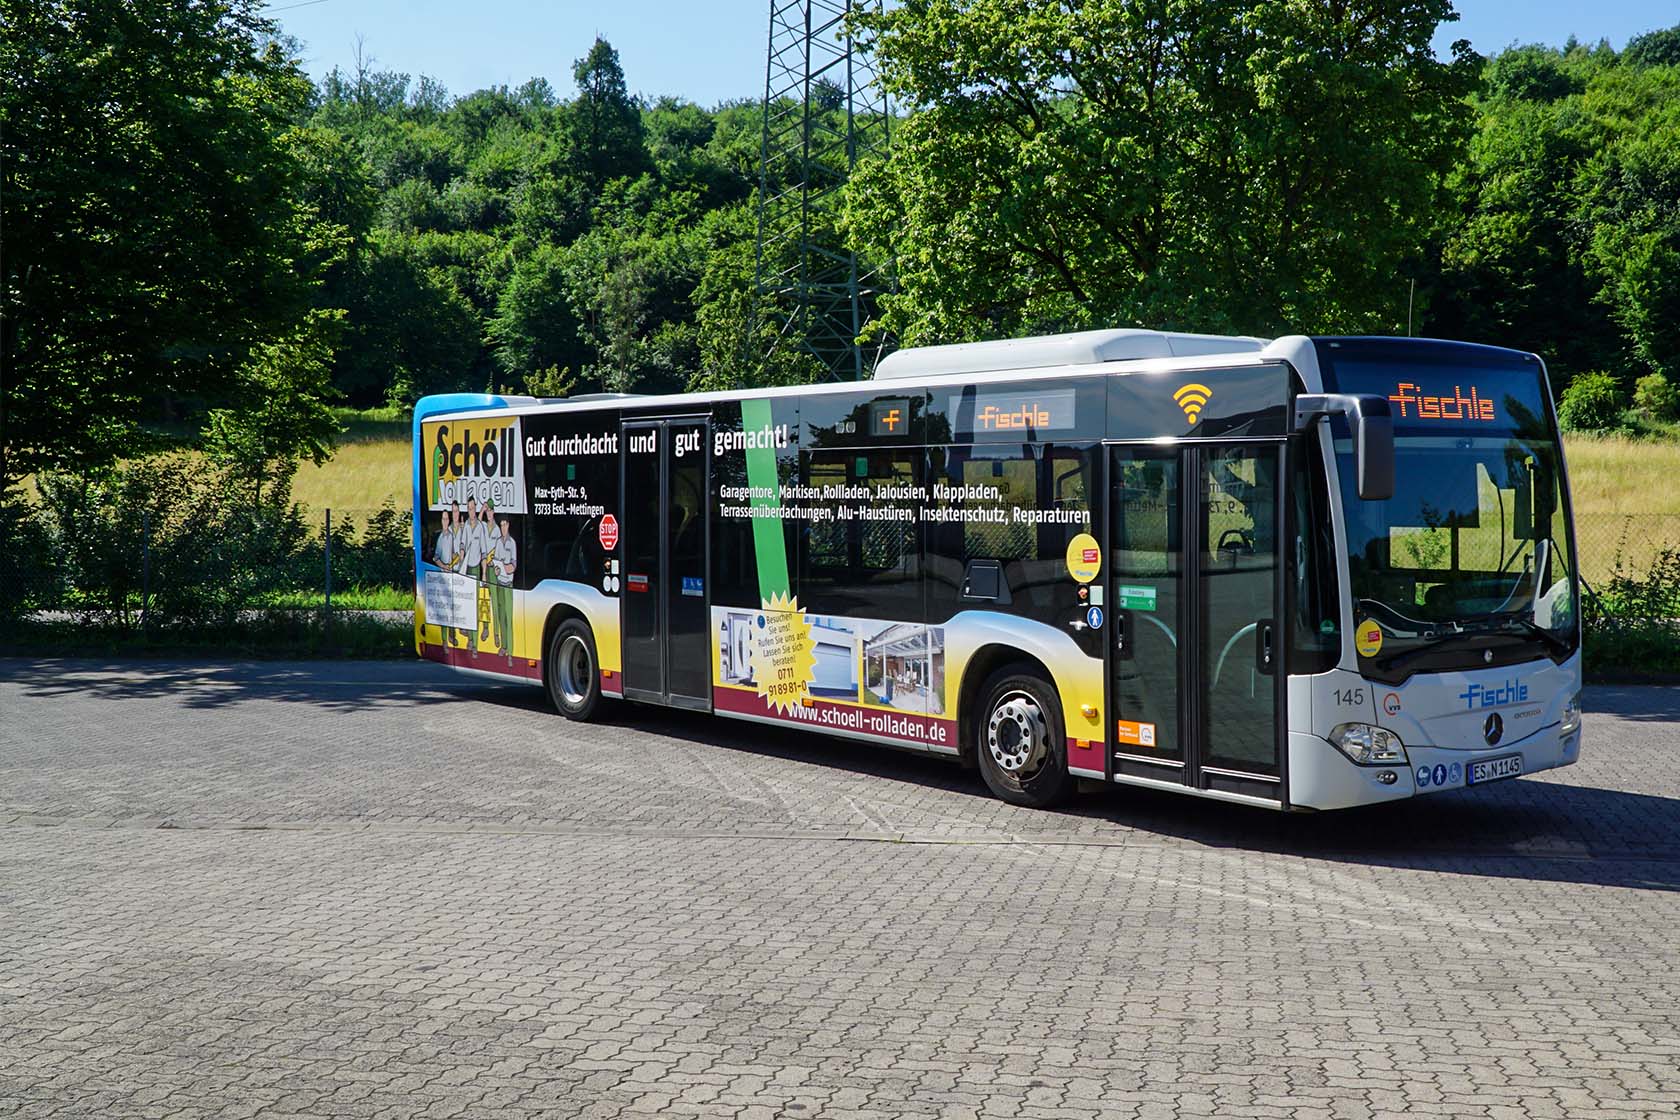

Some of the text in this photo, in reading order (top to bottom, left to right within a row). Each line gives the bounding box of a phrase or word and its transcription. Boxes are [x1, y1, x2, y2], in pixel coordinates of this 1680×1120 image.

[526, 424, 788, 458] Gut durchdacht und gut gemacht!
[437, 425, 515, 478] Schöll
[534, 486, 588, 501] Max-Eyth-Str. 9,
[720, 484, 776, 501] Garagentore,
[876, 483, 930, 502] Jalousien,
[933, 483, 1003, 502] Klappladen,
[534, 503, 605, 518] 73733 Essl.-Mettingen
[719, 503, 1091, 526] Terrassenüberdachungen, Alu-Haustüren, Insektenschutz, Reparaturen
[600, 523, 616, 534] STOP
[766, 613, 793, 625] Besuchen
[768, 625, 777, 635] Sie
[775, 636, 784, 645] Sie
[785, 634, 796, 642] uns
[796, 631, 806, 641] an!
[782, 644, 791, 653] Sie
[777, 667, 794, 681] 0711
[1333, 688, 1364, 706] 145
[1459, 678, 1529, 709] Fischle
[788, 702, 947, 742] www.schoell-rolladen.de
[1473, 764, 1487, 780] ES
